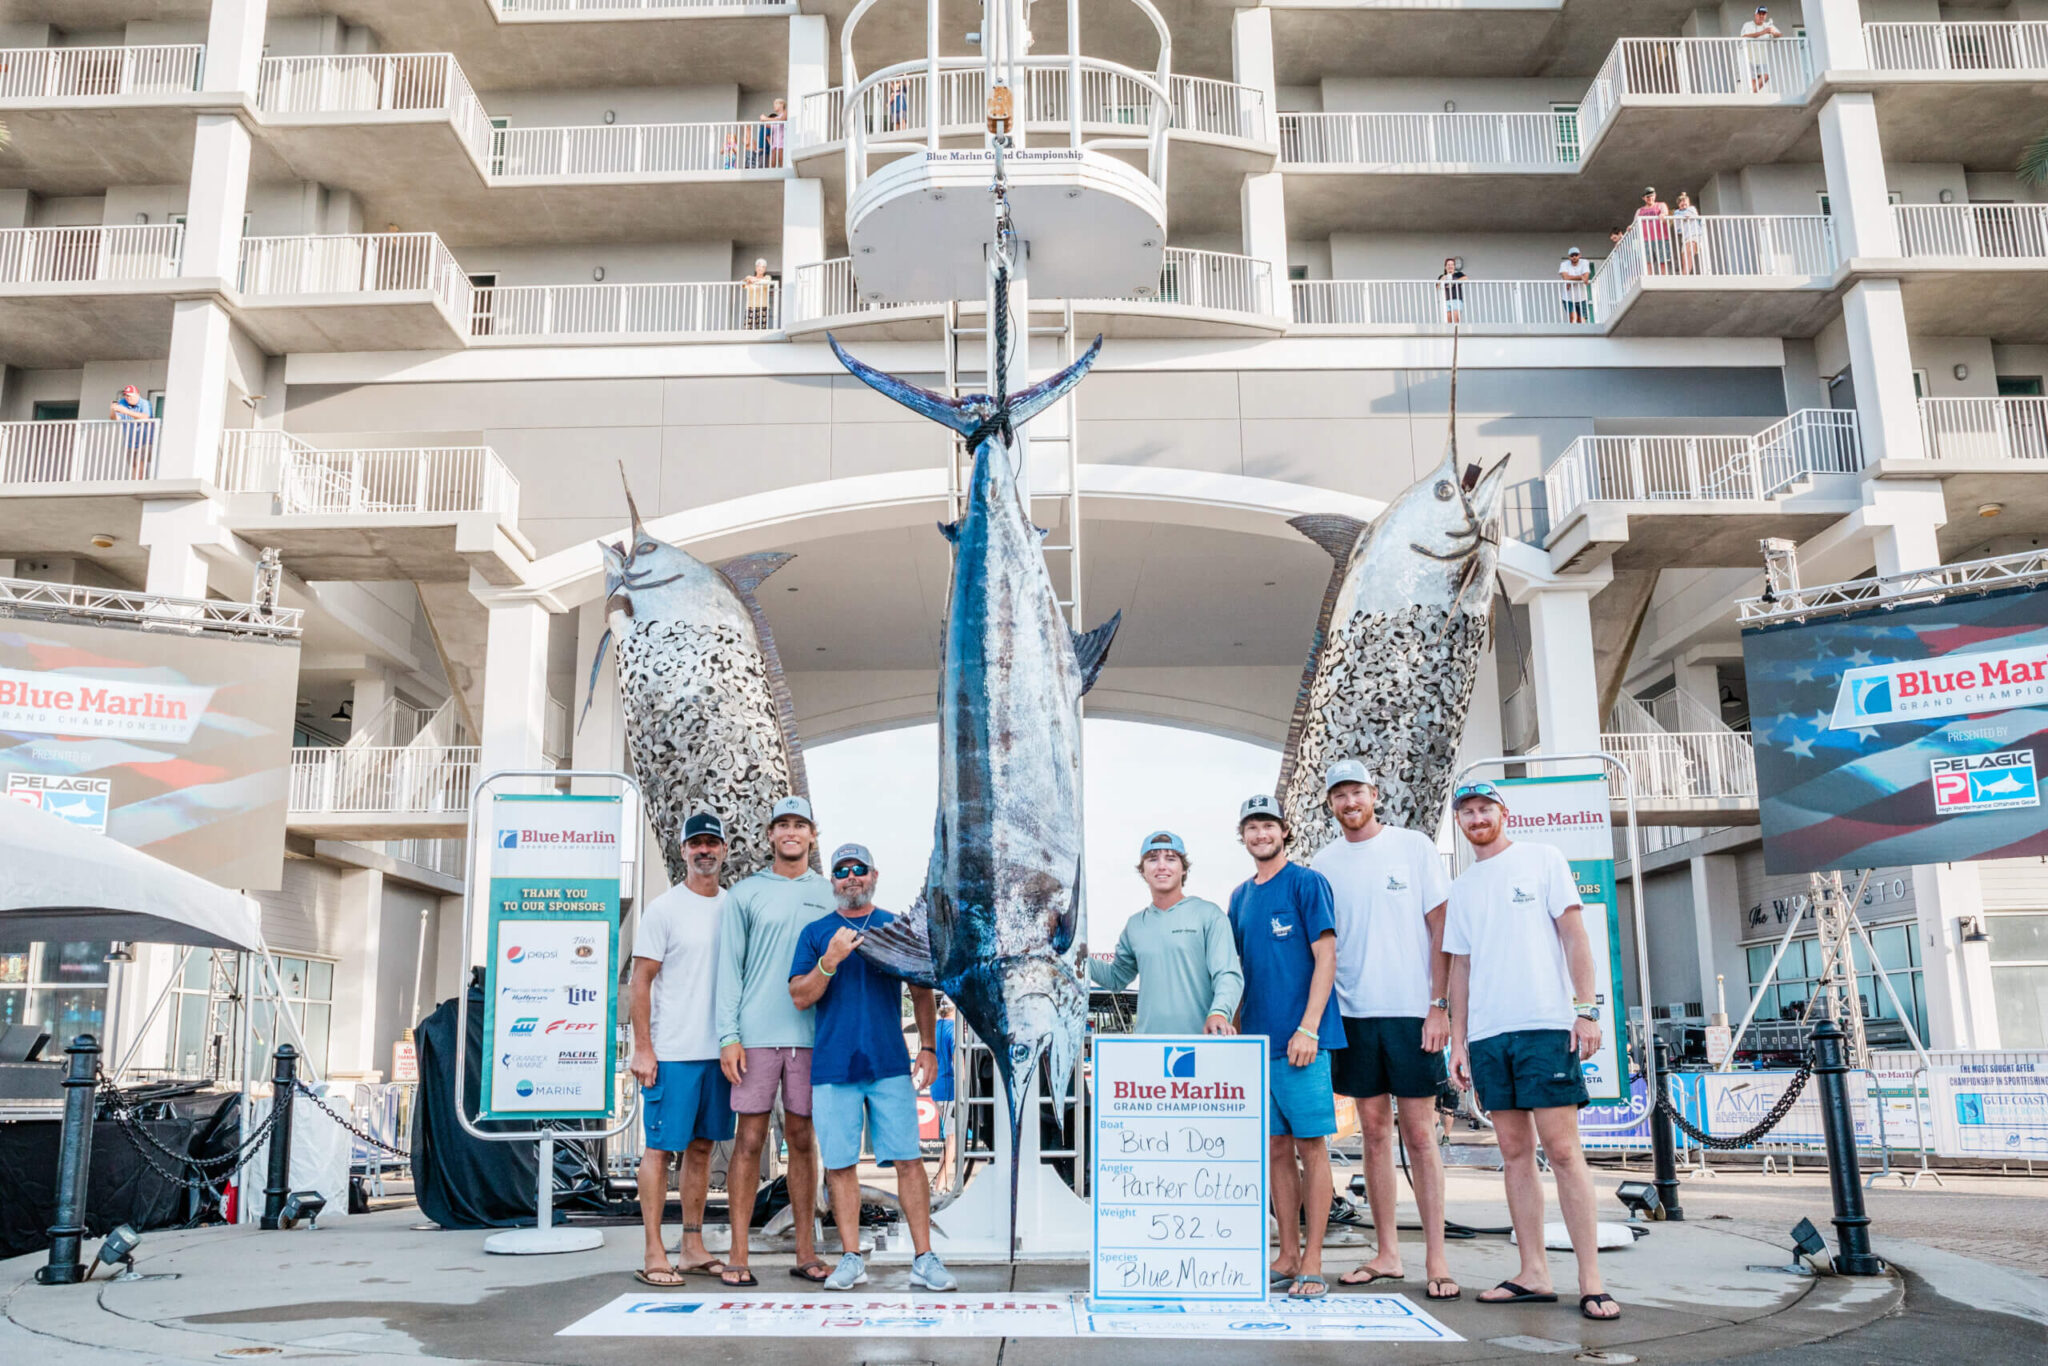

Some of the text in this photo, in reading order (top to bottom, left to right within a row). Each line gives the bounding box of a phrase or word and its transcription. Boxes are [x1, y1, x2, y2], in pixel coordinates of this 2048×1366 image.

[926, 150, 1084, 161] Blue Marlin Grnd Championship
[1896, 655, 2048, 698] Blue Mar
[0, 680, 187, 720] Blue Marlin
[1900, 686, 2044, 711] GRAND CHAMPIO
[58, 715, 187, 733] CHAMPIONSHIP
[1947, 726, 2009, 743] PRESENTED BY
[31, 748, 91, 762] PRESENTED BY
[1933, 752, 2032, 773] PELAGIC
[10, 775, 108, 793] PELAGIC
[1953, 803, 1992, 811] Performance
[1506, 811, 1604, 828] Blue Marlin
[1539, 825, 1605, 833] CHAMPIONSHIP
[521, 830, 616, 844] Blue Marlin
[521, 888, 588, 899] THANK YOU
[503, 901, 606, 912] TO OUR SPONSORS
[1749, 903, 1769, 929] The
[527, 950, 559, 960] pepsi
[568, 987, 598, 1006] Lite
[565, 1023, 599, 1031] FPT
[1960, 1063, 2035, 1074] THE MOST SOUGHT AFTER
[1584, 1076, 1603, 1084] STA
[1949, 1077, 1995, 1087] CHAMPIONSHIP
[1996, 1077, 2003, 1086] IN
[536, 1086, 582, 1096] MARINE
[1113, 1081, 1245, 1100] Blue Marlin
[1716, 1086, 1774, 1111] AME
[1983, 1095, 2045, 1105] GULF COAST
[1113, 1102, 1246, 1112] GRAND CHAMPIONSHIP
[1100, 1120, 1124, 1129] Boat
[1118, 1127, 1225, 1159] Bird Dog
[1100, 1164, 1134, 1174] Angler
[1112, 1168, 1260, 1201] Parker Cotton
[1100, 1208, 1137, 1219] Weight
[1100, 1253, 1138, 1263] Species
[1116, 1256, 1251, 1288] Blue Marlin
